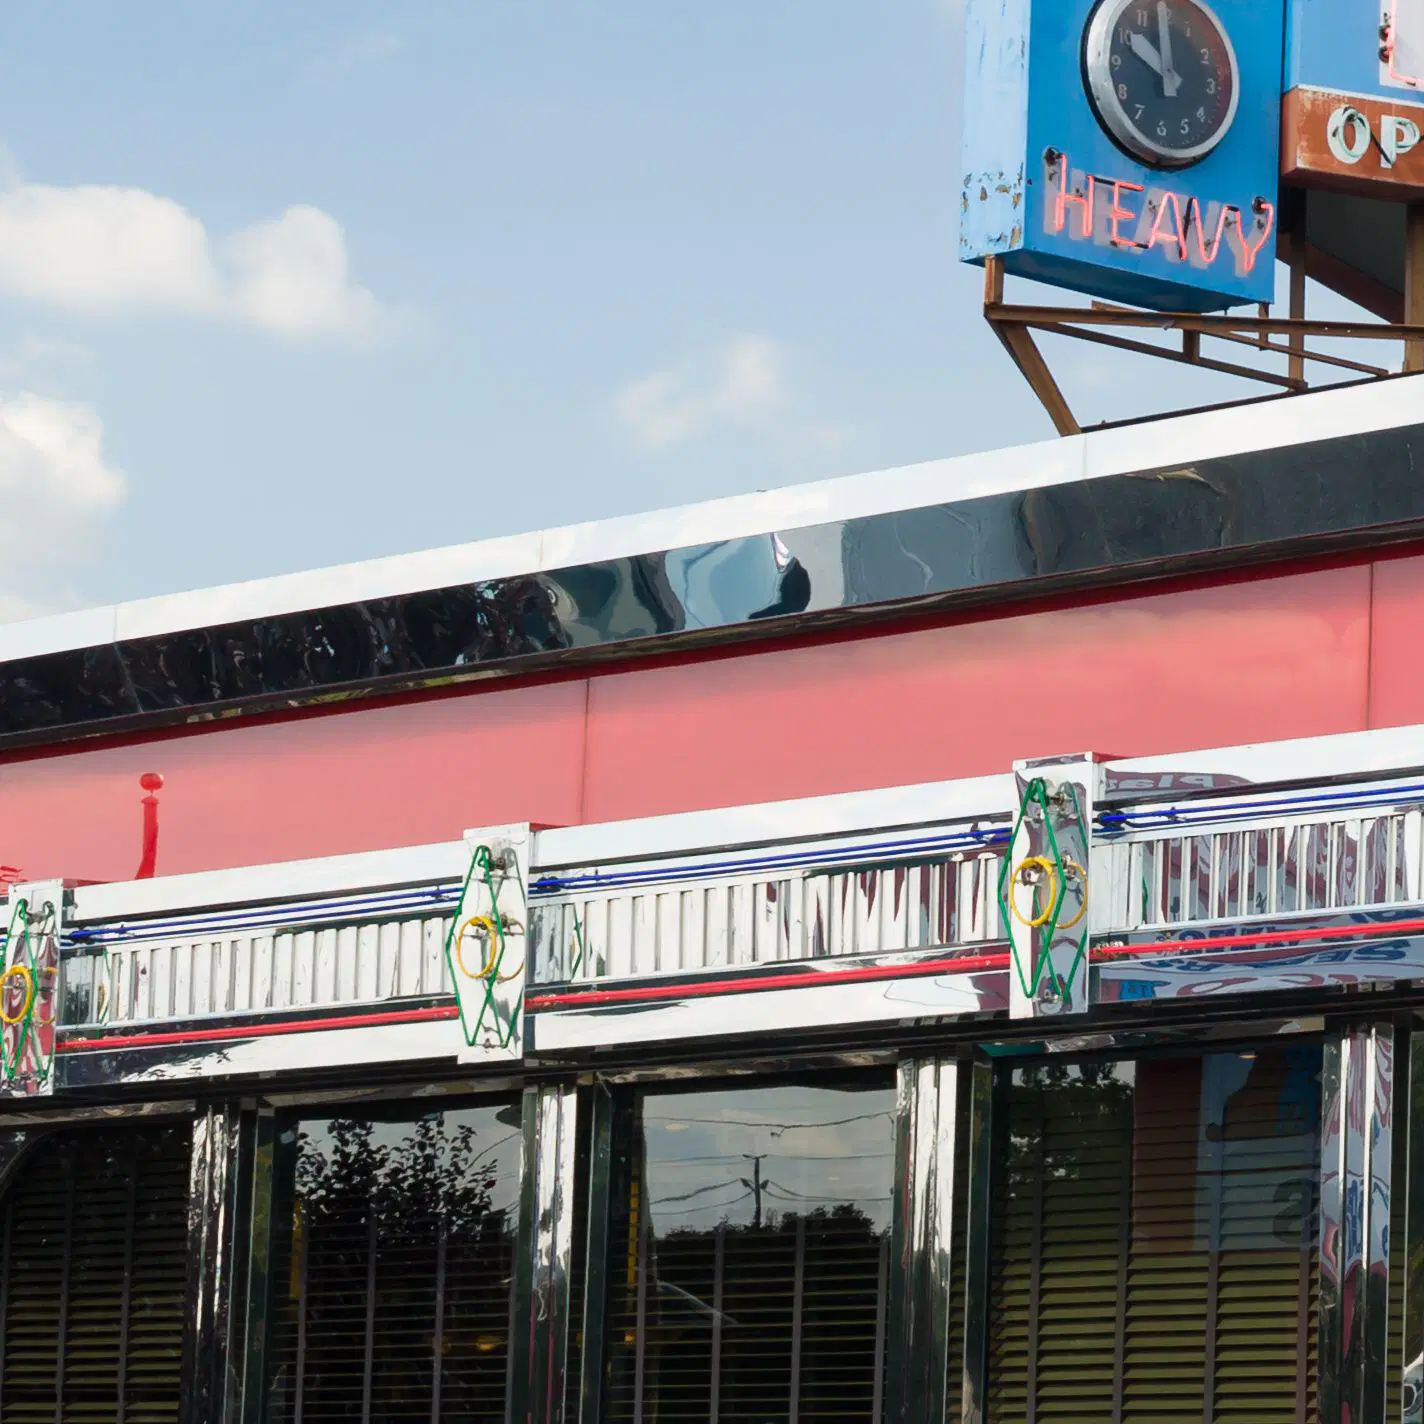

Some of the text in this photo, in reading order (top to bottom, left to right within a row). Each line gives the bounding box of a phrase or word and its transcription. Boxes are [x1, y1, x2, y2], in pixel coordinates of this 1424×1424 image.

[1111, 54, 1122, 71] 9
[1200, 48, 1210, 64] 2
[1117, 83, 1128, 100] 8
[1206, 78, 1216, 94] 3
[1134, 103, 1146, 120] 7
[1156, 120, 1167, 136] 6
[1180, 118, 1189, 134] 5
[1043, 149, 1274, 278] HEAVY
